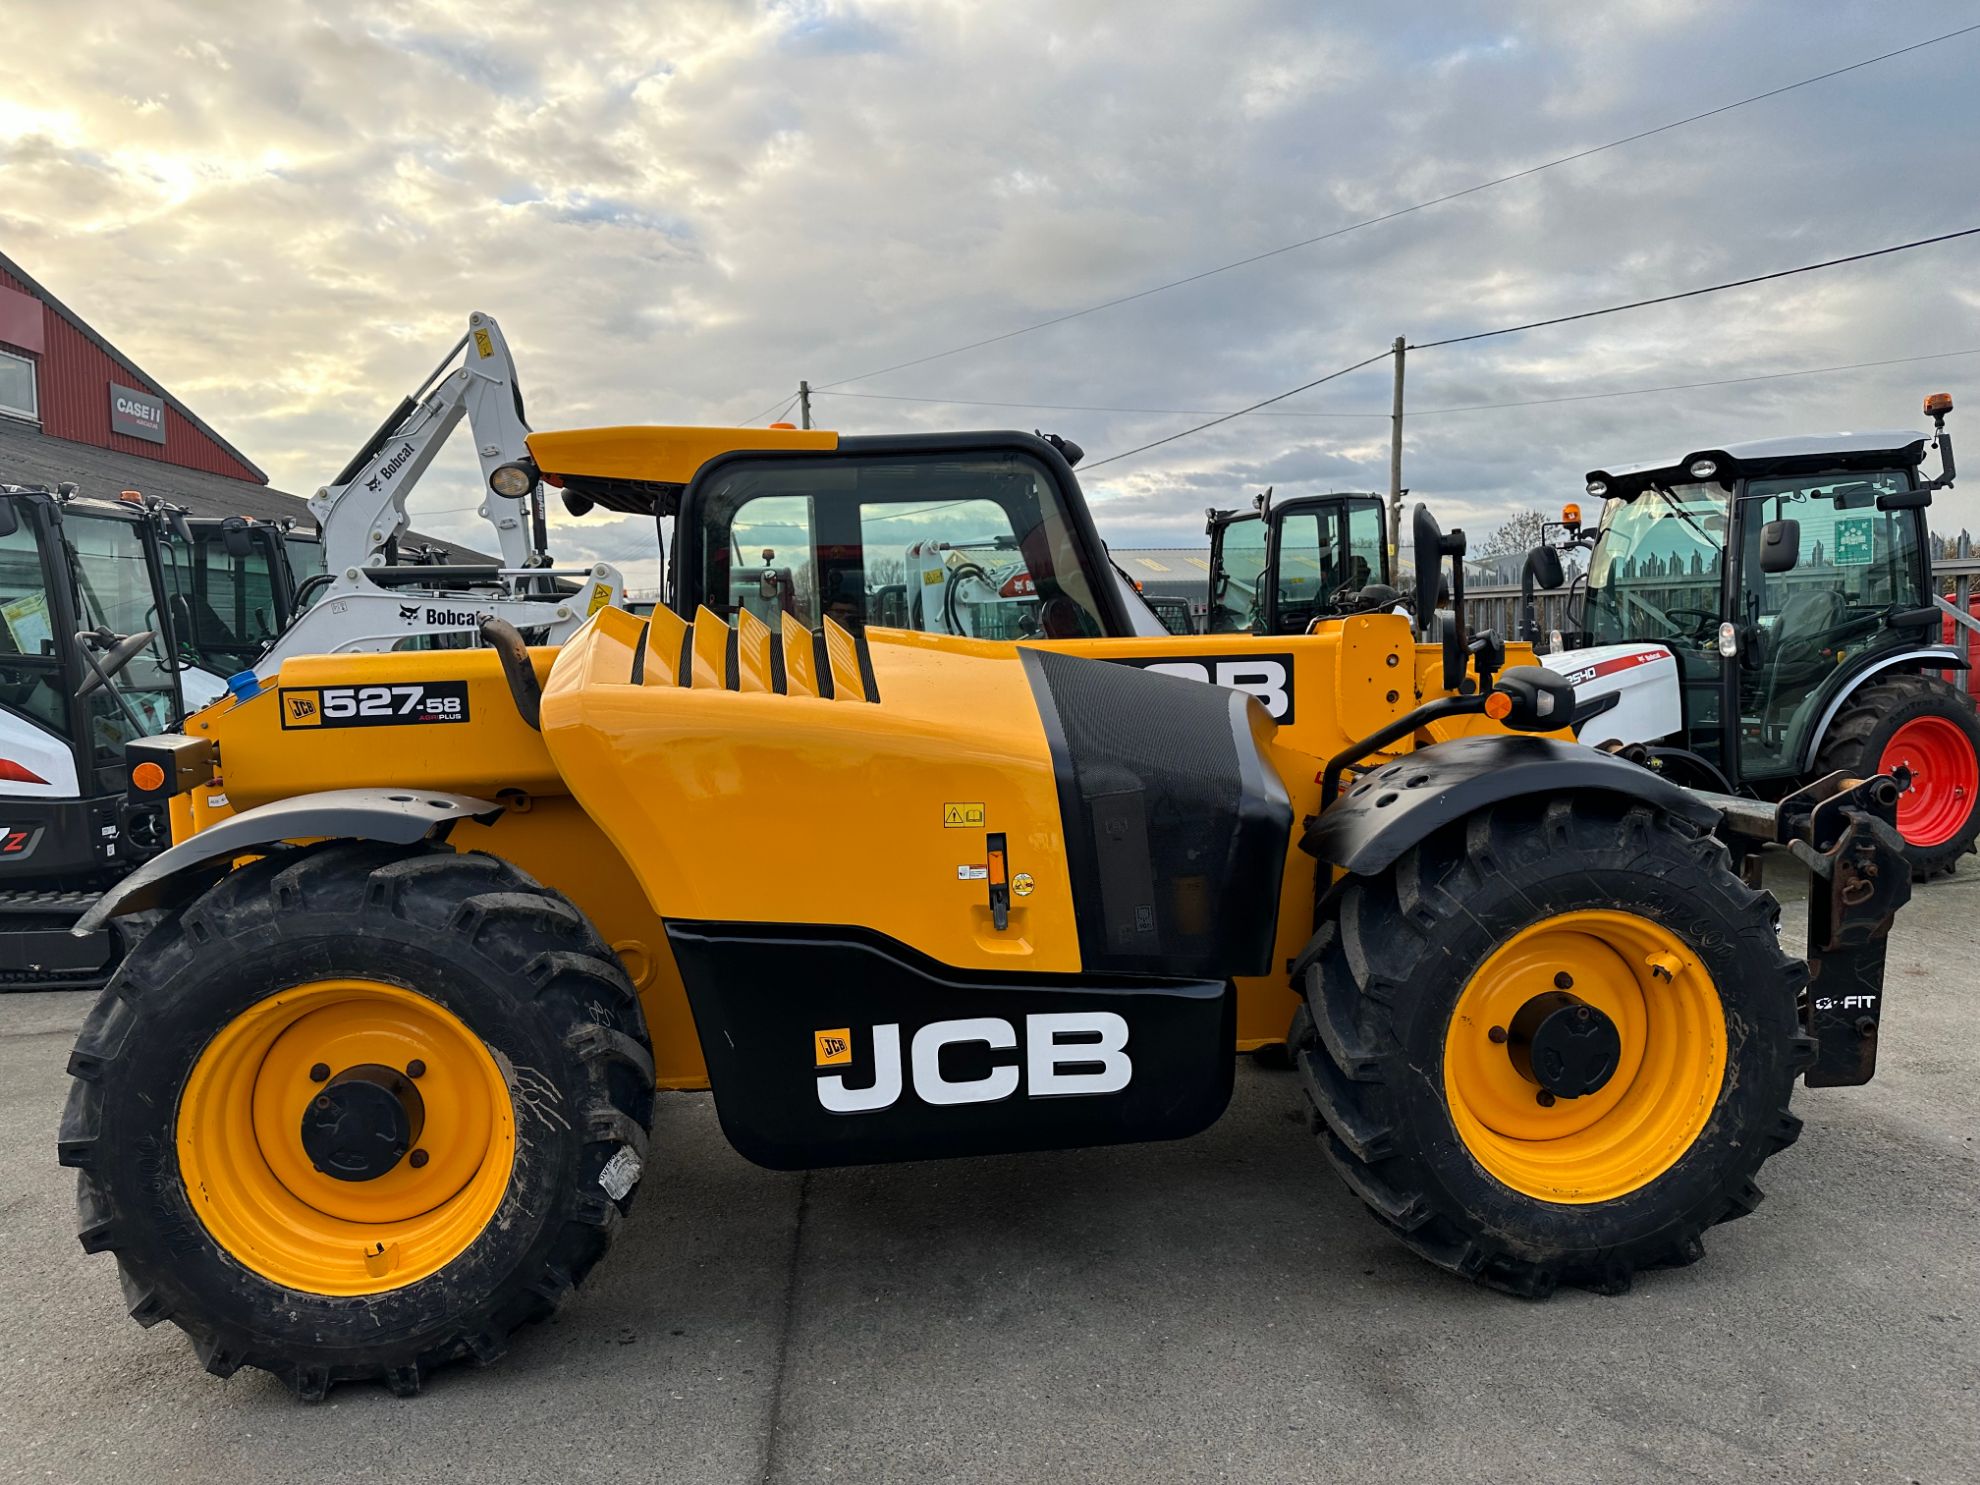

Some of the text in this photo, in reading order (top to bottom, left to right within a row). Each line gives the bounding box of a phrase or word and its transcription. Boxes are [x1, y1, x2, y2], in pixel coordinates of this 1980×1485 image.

[117, 398, 149, 419] CASE
[380, 442, 415, 480] Bobcat
[293, 700, 315, 717] JCB
[323, 686, 461, 718] 527-58
[824, 1038, 846, 1055] JCB
[817, 1012, 1132, 1113] JCB
